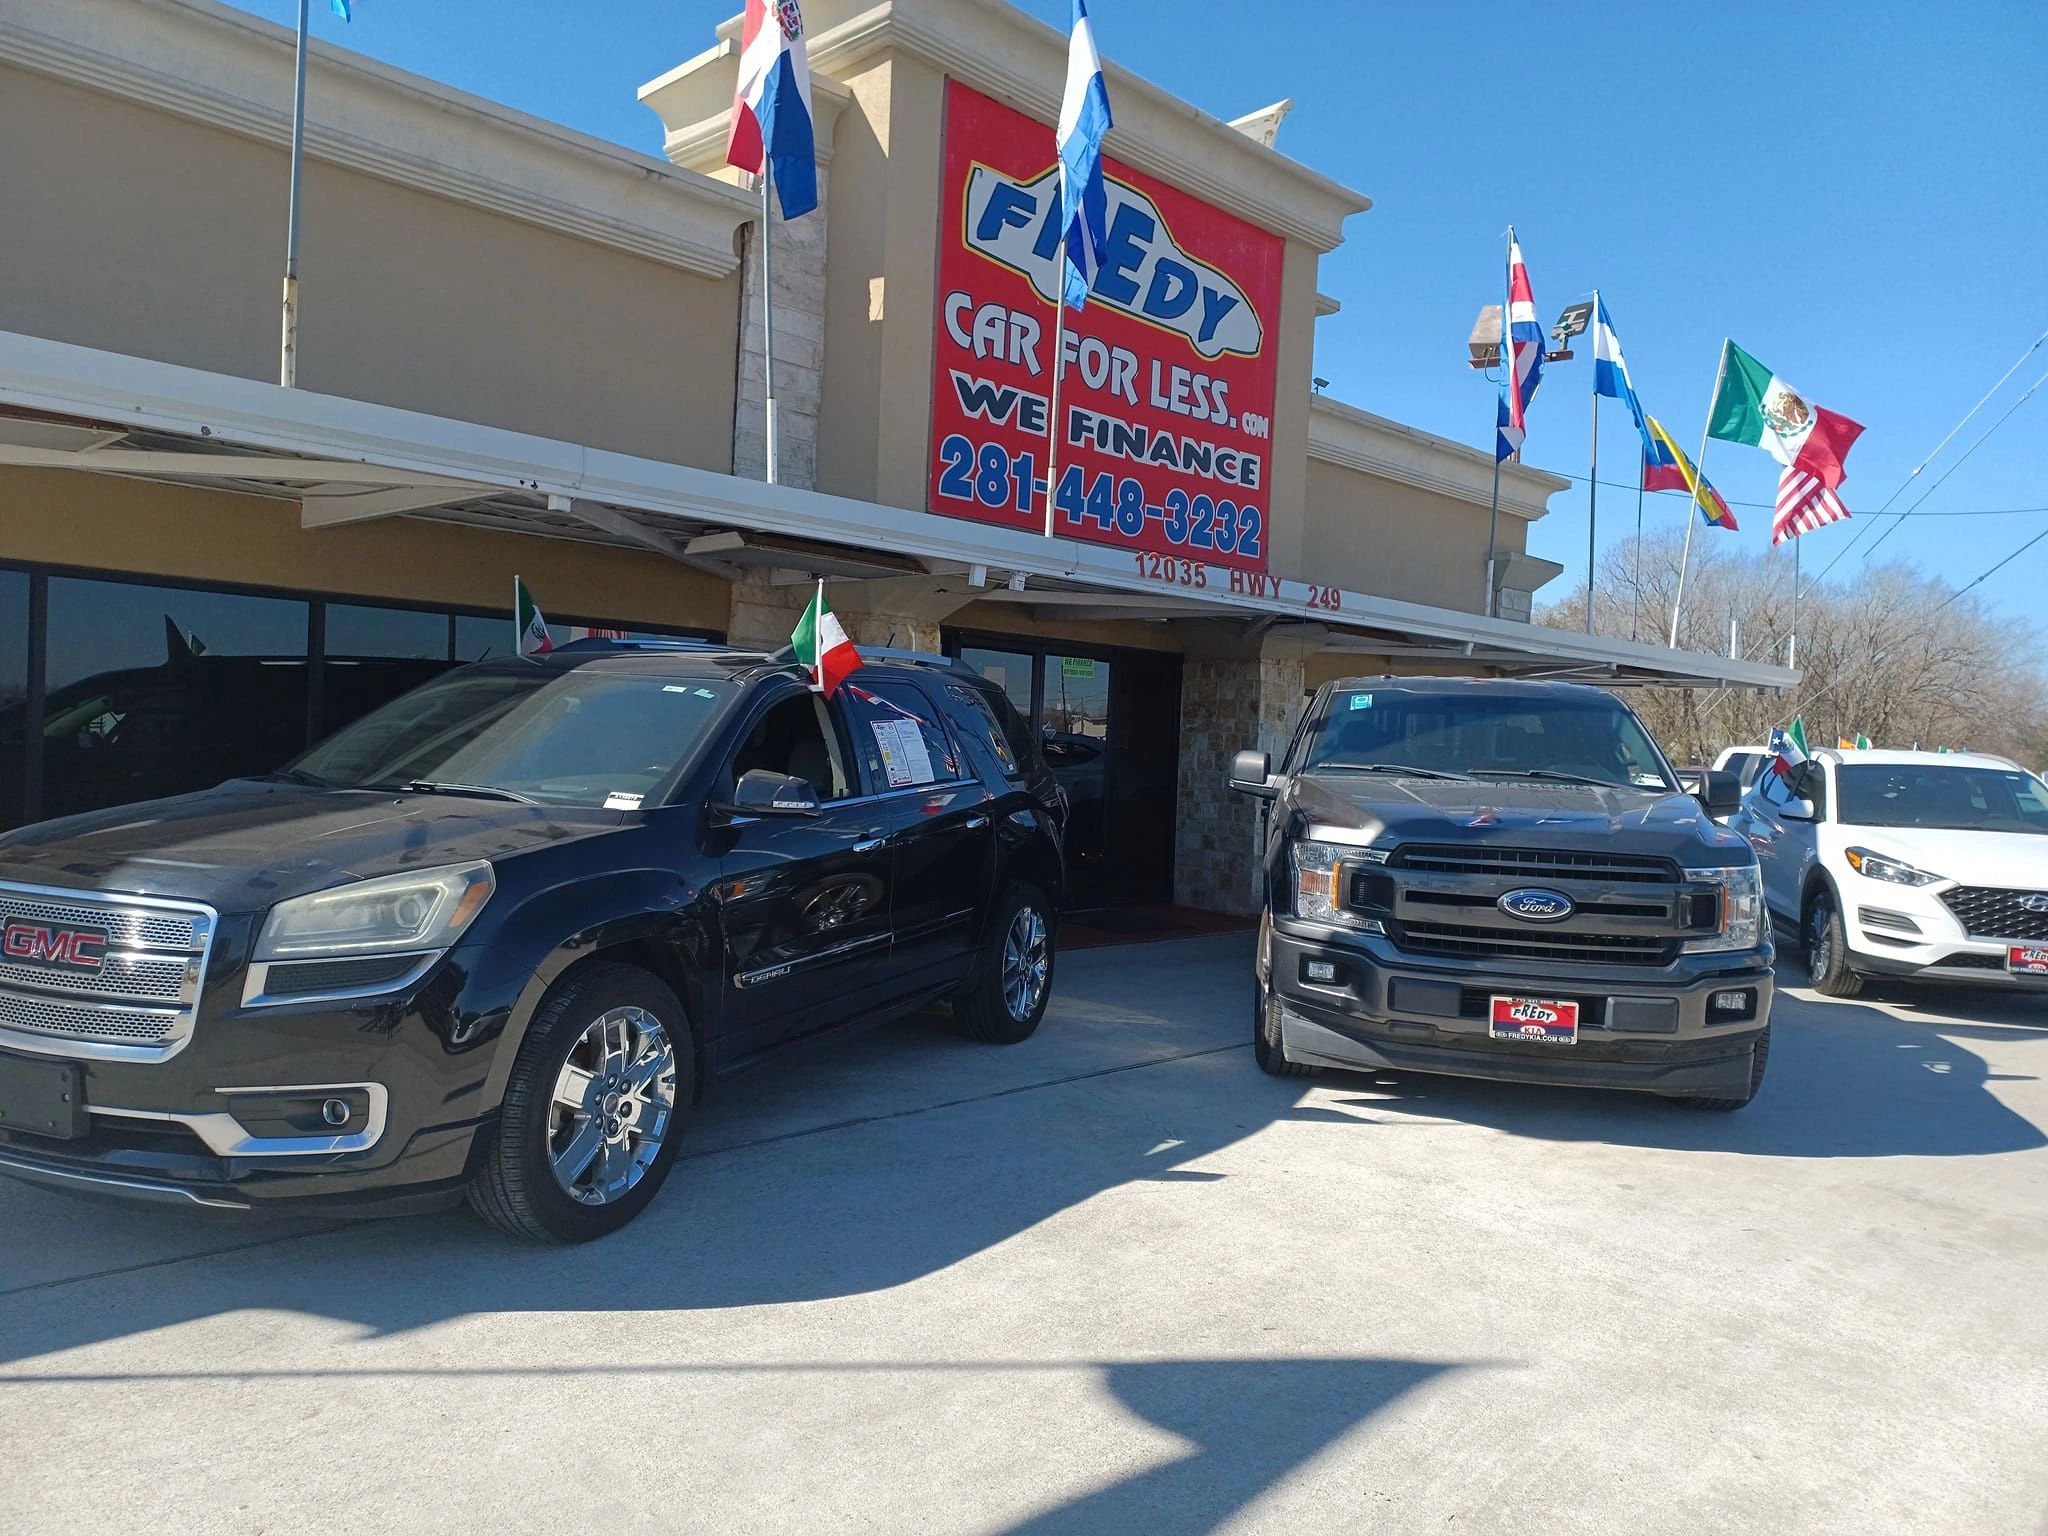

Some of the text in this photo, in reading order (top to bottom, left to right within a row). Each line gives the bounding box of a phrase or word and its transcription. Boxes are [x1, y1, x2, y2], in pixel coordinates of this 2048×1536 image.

[944, 290, 1043, 377] CAR
[1058, 328, 1140, 407] FOR
[949, 368, 1261, 490] WE FINANCE
[938, 433, 1262, 558] 281-448-3232
[1135, 552, 1341, 611] 12035 HWY 249
[1519, 897, 1556, 913] Ford
[4, 924, 108, 967] GMC
[750, 966, 791, 984] DENALI
[1513, 1004, 1553, 1021] FREDY
[1508, 1032, 1558, 1042] FREDYKIA.COM
[1525, 1027, 1542, 1035] KIA
